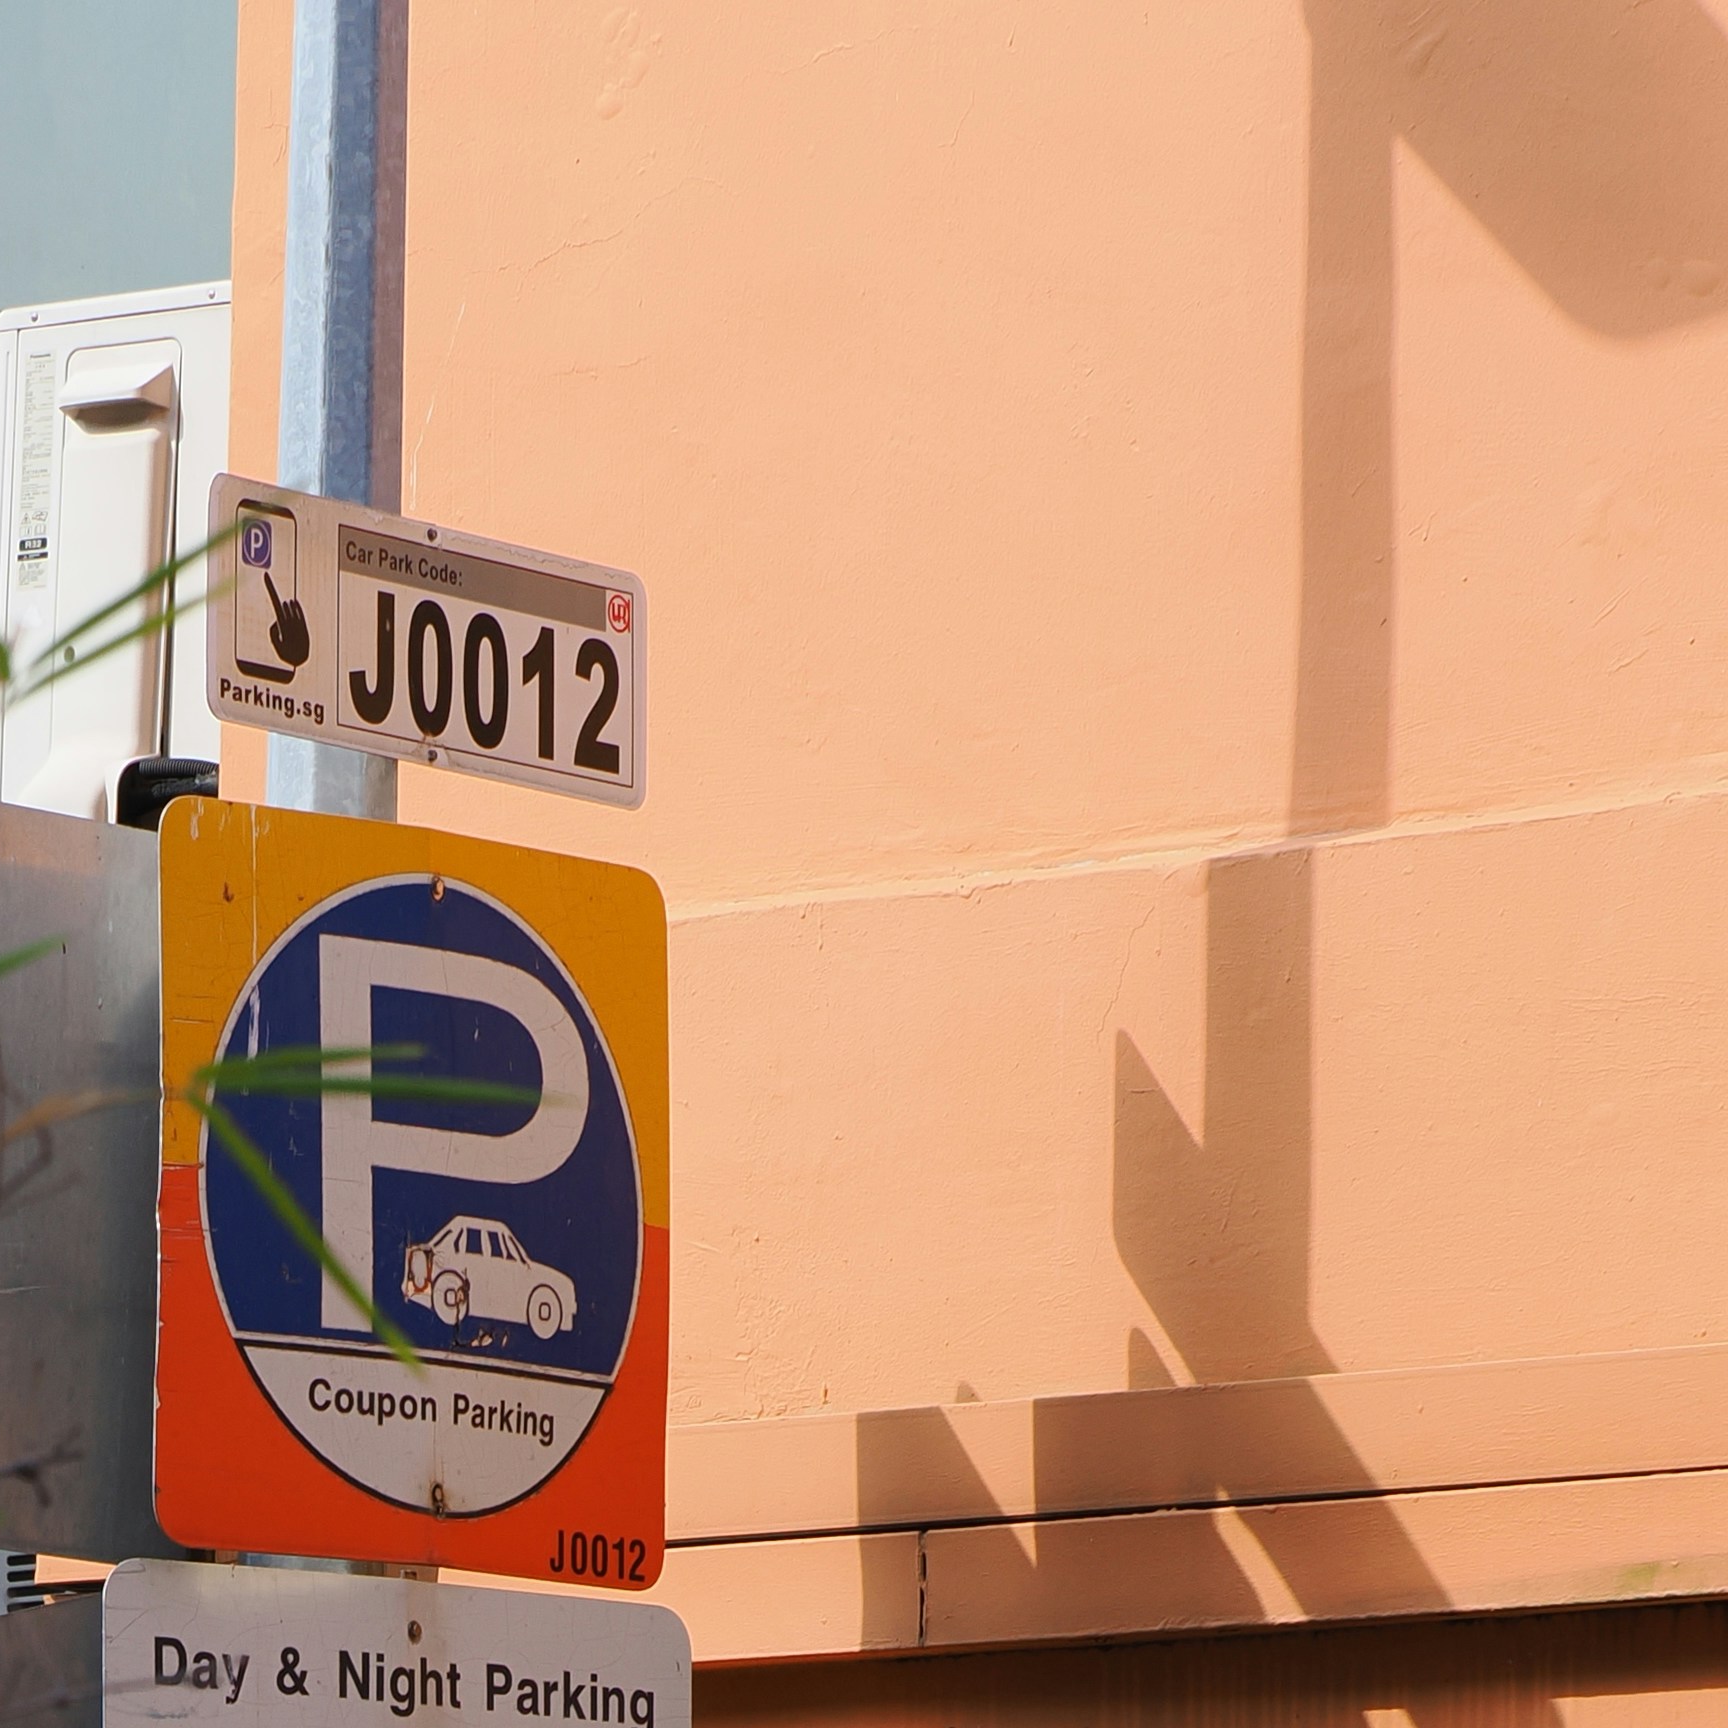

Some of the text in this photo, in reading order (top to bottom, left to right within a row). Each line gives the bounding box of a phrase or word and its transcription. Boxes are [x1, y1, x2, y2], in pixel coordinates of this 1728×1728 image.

[346, 540, 464, 587] Car Park Code:
[220, 678, 325, 724] Parking.sg
[349, 590, 620, 775] J0012
[319, 933, 590, 1333] P
[308, 1378, 556, 1447] Coupon Parking
[549, 1530, 647, 1583] J0012
[154, 1636, 249, 1704] Day
[276, 1646, 310, 1697] &
[338, 1650, 462, 1718] Night
